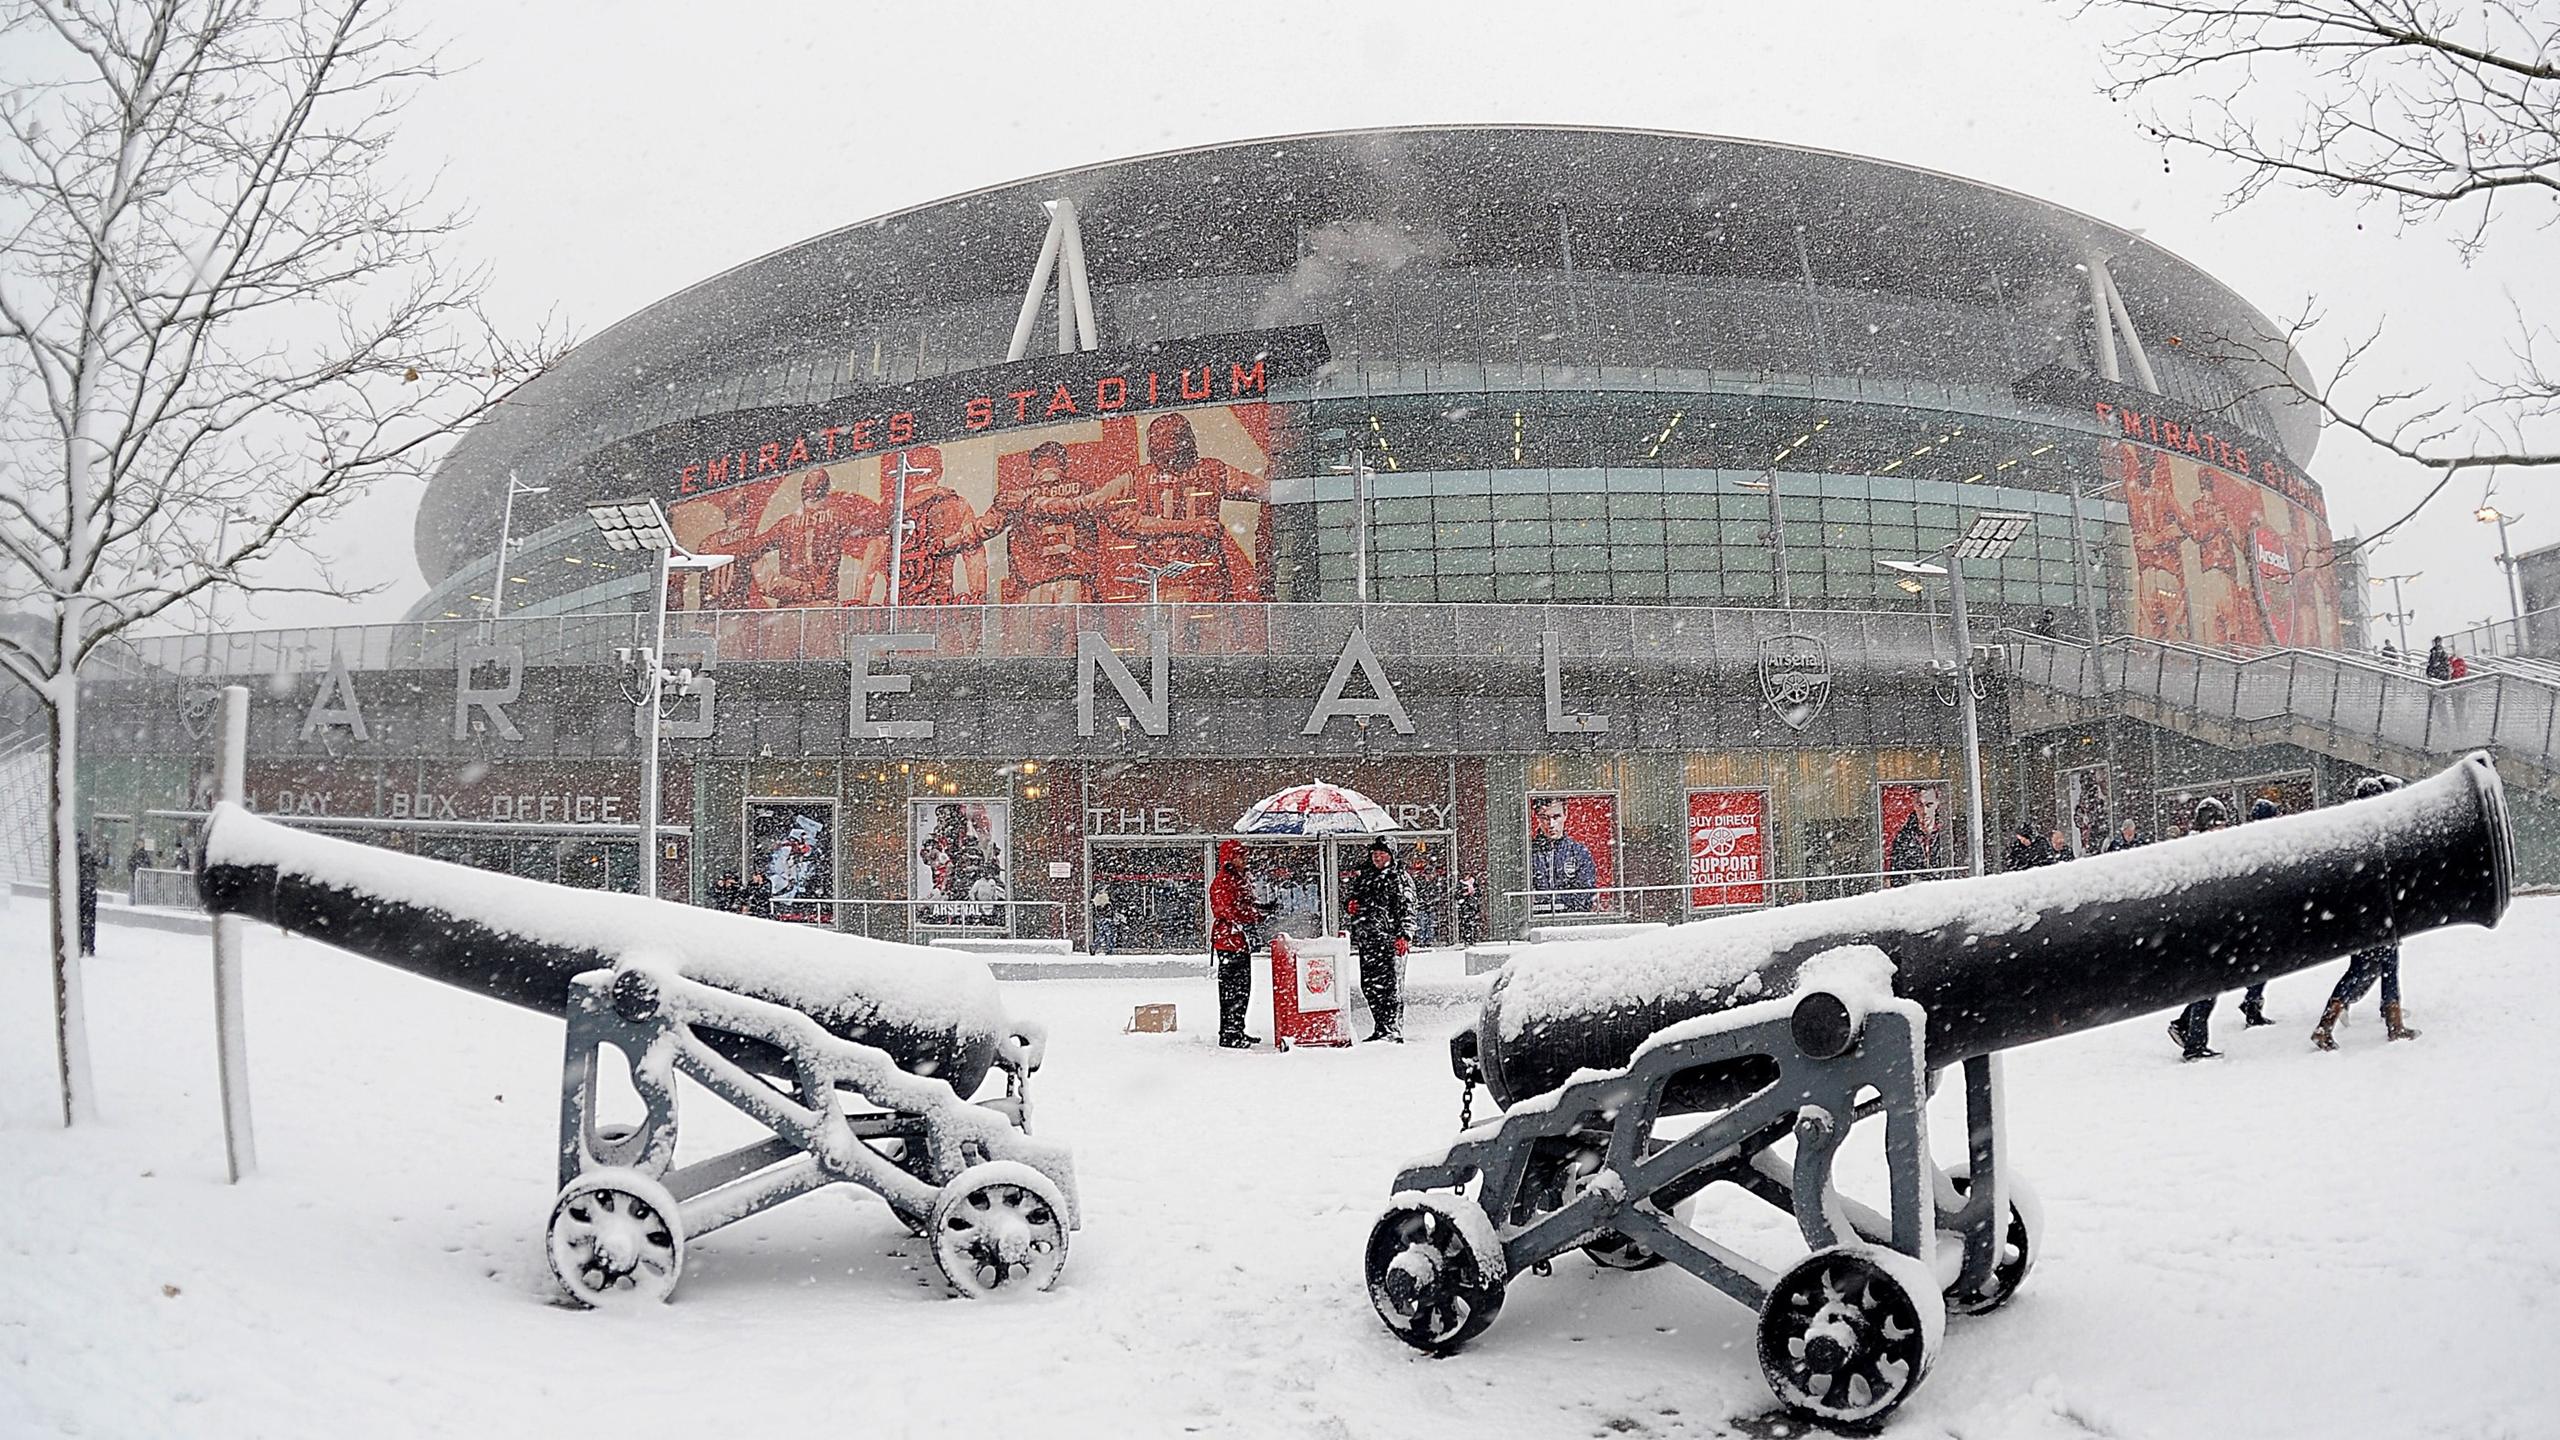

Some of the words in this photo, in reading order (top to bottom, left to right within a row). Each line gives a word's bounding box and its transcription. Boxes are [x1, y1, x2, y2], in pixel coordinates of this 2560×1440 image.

[682, 412, 913, 493] EMIRATES
[966, 361, 1266, 431] STADIUM
[300, 626, 1609, 742] ARSENAL
[278, 790, 332, 816] DAY
[392, 793, 458, 820] BOX
[493, 794, 622, 824] OFFICE
[1087, 806, 1177, 835] THE
[1690, 815, 1712, 828] BUY
[1715, 814, 1756, 827] DIRECT
[1691, 855, 1759, 874] SUPPORT
[1690, 872, 1723, 885] YOUR
[1726, 870, 1757, 882] CLUB
[933, 903, 981, 916] ARSENAL
